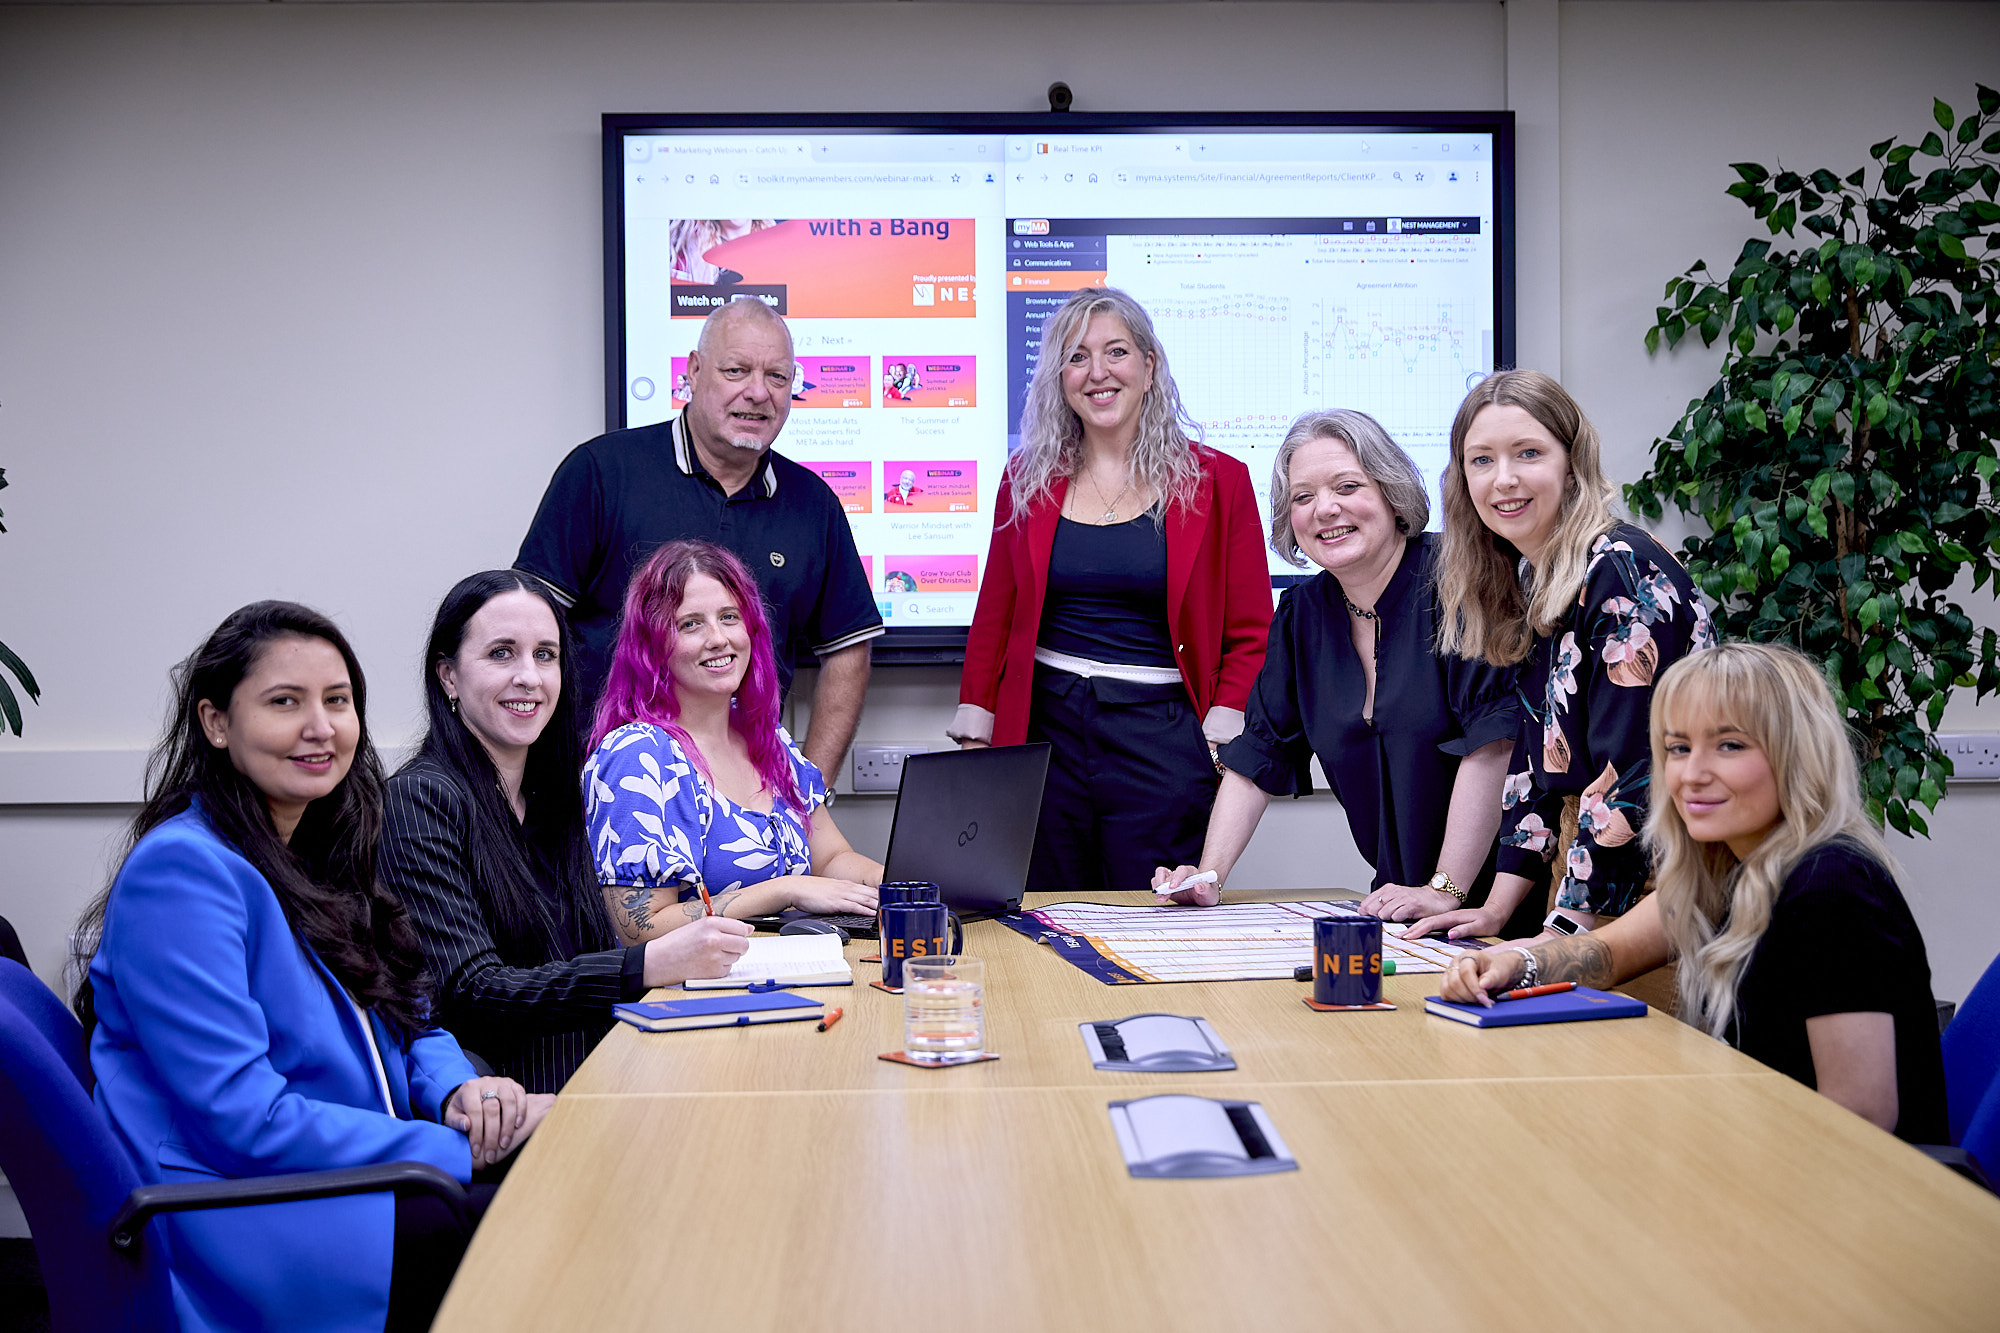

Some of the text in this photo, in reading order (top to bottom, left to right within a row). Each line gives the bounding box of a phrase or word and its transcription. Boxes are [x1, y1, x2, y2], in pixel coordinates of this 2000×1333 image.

[755, 146, 779, 154] Catch
[1053, 144, 1103, 153] Real Time KPI
[809, 218, 950, 240] with a Bang
[1401, 221, 1460, 229] NEST MANAGEMENT
[1024, 240, 1039, 249] Web
[1039, 240, 1054, 249] Tools
[1060, 240, 1075, 250] Apps
[1024, 259, 1072, 267] Communications
[913, 275, 937, 284] Proudly
[938, 275, 969, 284] presented
[1025, 277, 1050, 286] Financial
[1356, 281, 1418, 290] Agreement Attrition
[677, 295, 710, 307] Watch
[711, 296, 725, 307] on
[1025, 297, 1047, 305] Browse
[1025, 311, 1046, 319] Annual
[822, 335, 844, 345] Next
[791, 417, 858, 426] Most Martial Arts
[901, 416, 960, 425] The Summer of
[788, 427, 861, 436] school owners find
[915, 427, 945, 436] Success
[795, 438, 854, 447] META ads hard
[890, 520, 972, 530] Warrior Mindset with
[908, 532, 954, 541] Lee Sansum
[925, 604, 954, 614] Search
[884, 937, 944, 958] EST
